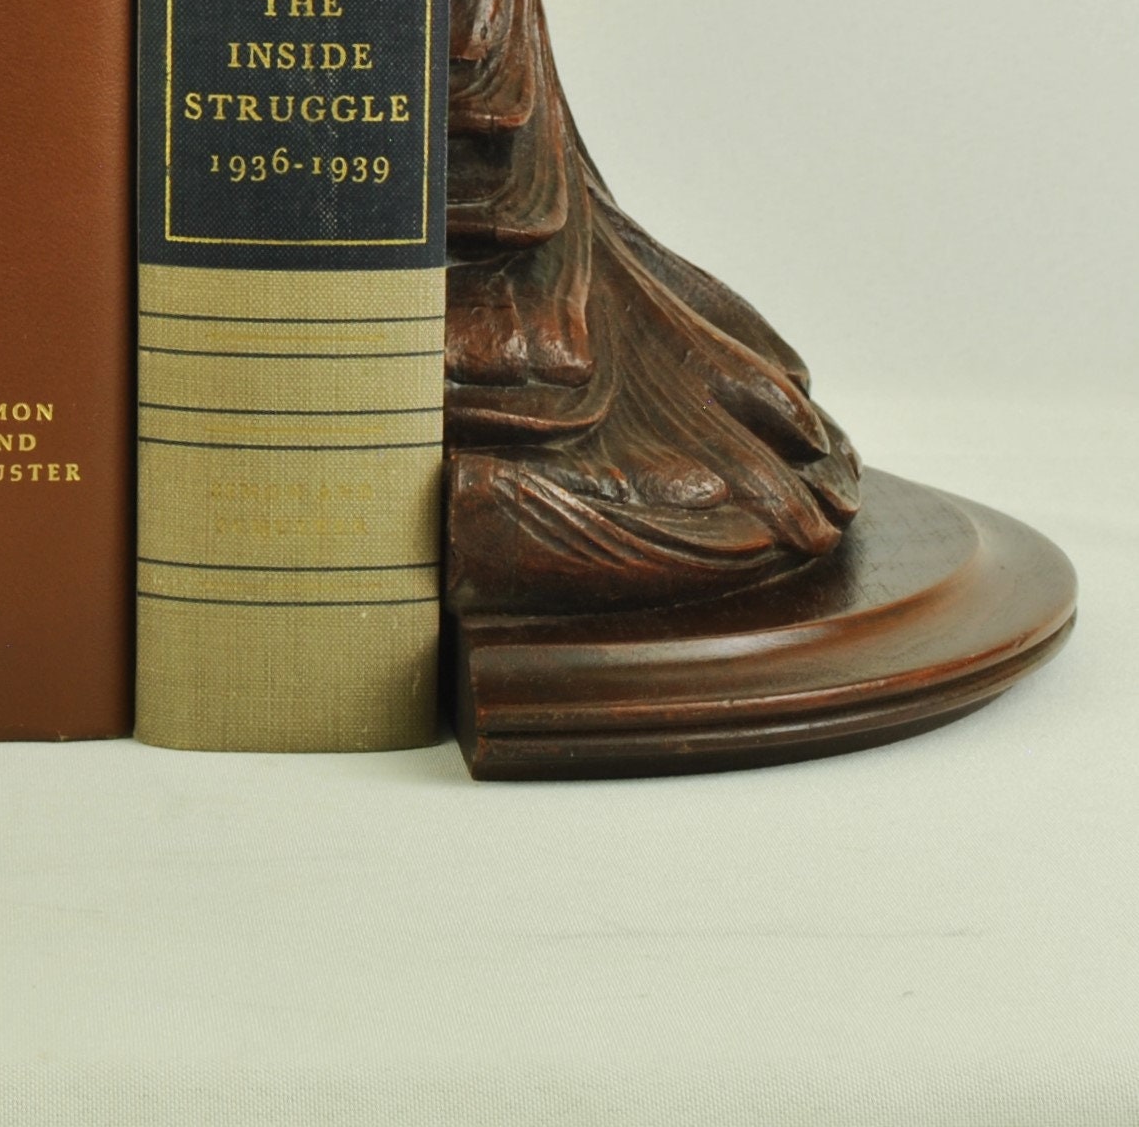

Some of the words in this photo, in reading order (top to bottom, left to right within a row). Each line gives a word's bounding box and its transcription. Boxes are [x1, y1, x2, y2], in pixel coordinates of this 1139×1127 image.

[227, 42, 374, 70] INSIDE
[184, 93, 411, 123] STRUGGLE
[210, 147, 391, 184] 1936-1939
